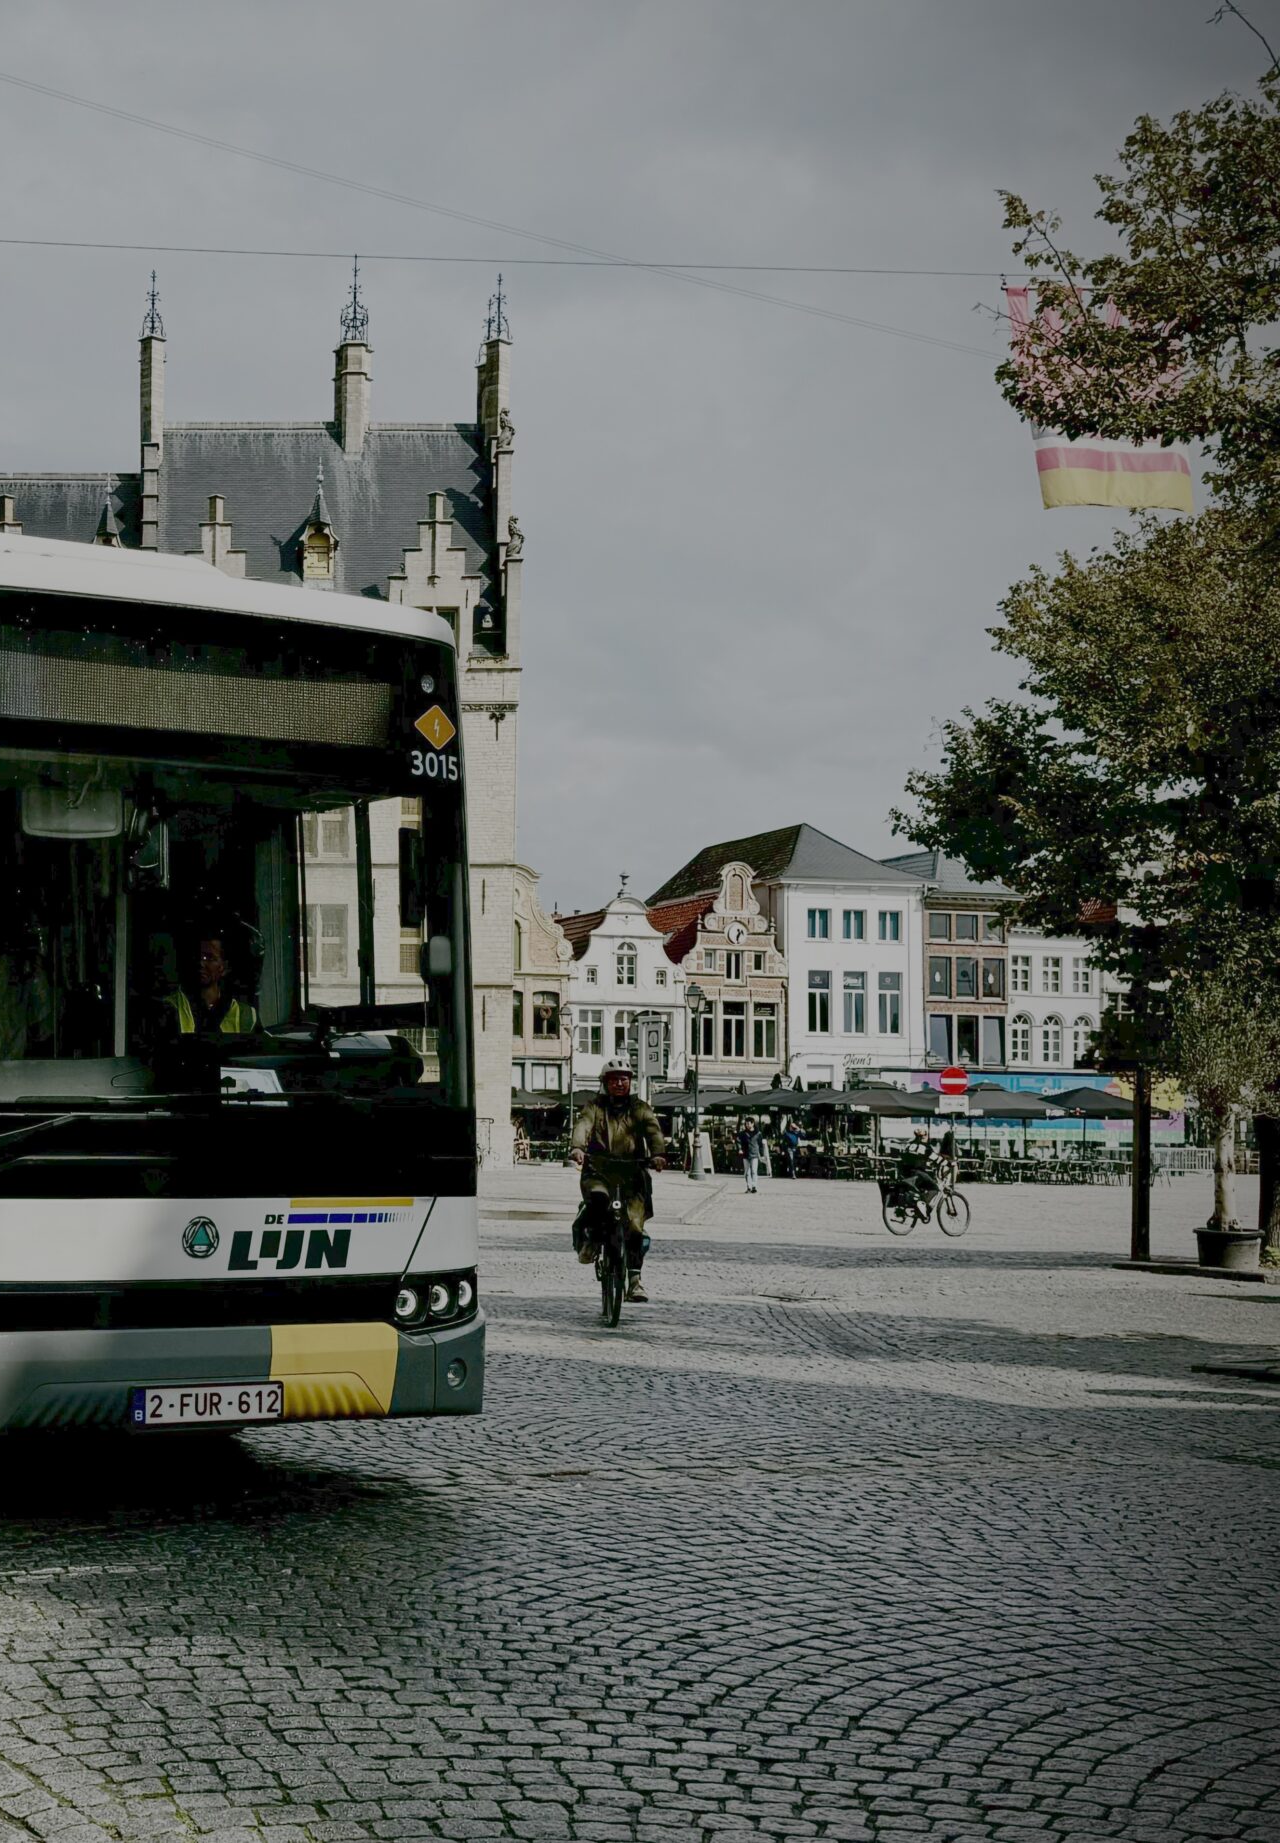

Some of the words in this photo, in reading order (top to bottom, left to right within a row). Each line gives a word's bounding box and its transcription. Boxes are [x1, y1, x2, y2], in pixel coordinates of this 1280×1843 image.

[410, 749, 458, 781] 3015
[264, 1213, 285, 1225] DE
[227, 1229, 352, 1271] LIJN
[134, 1409, 144, 1421] B
